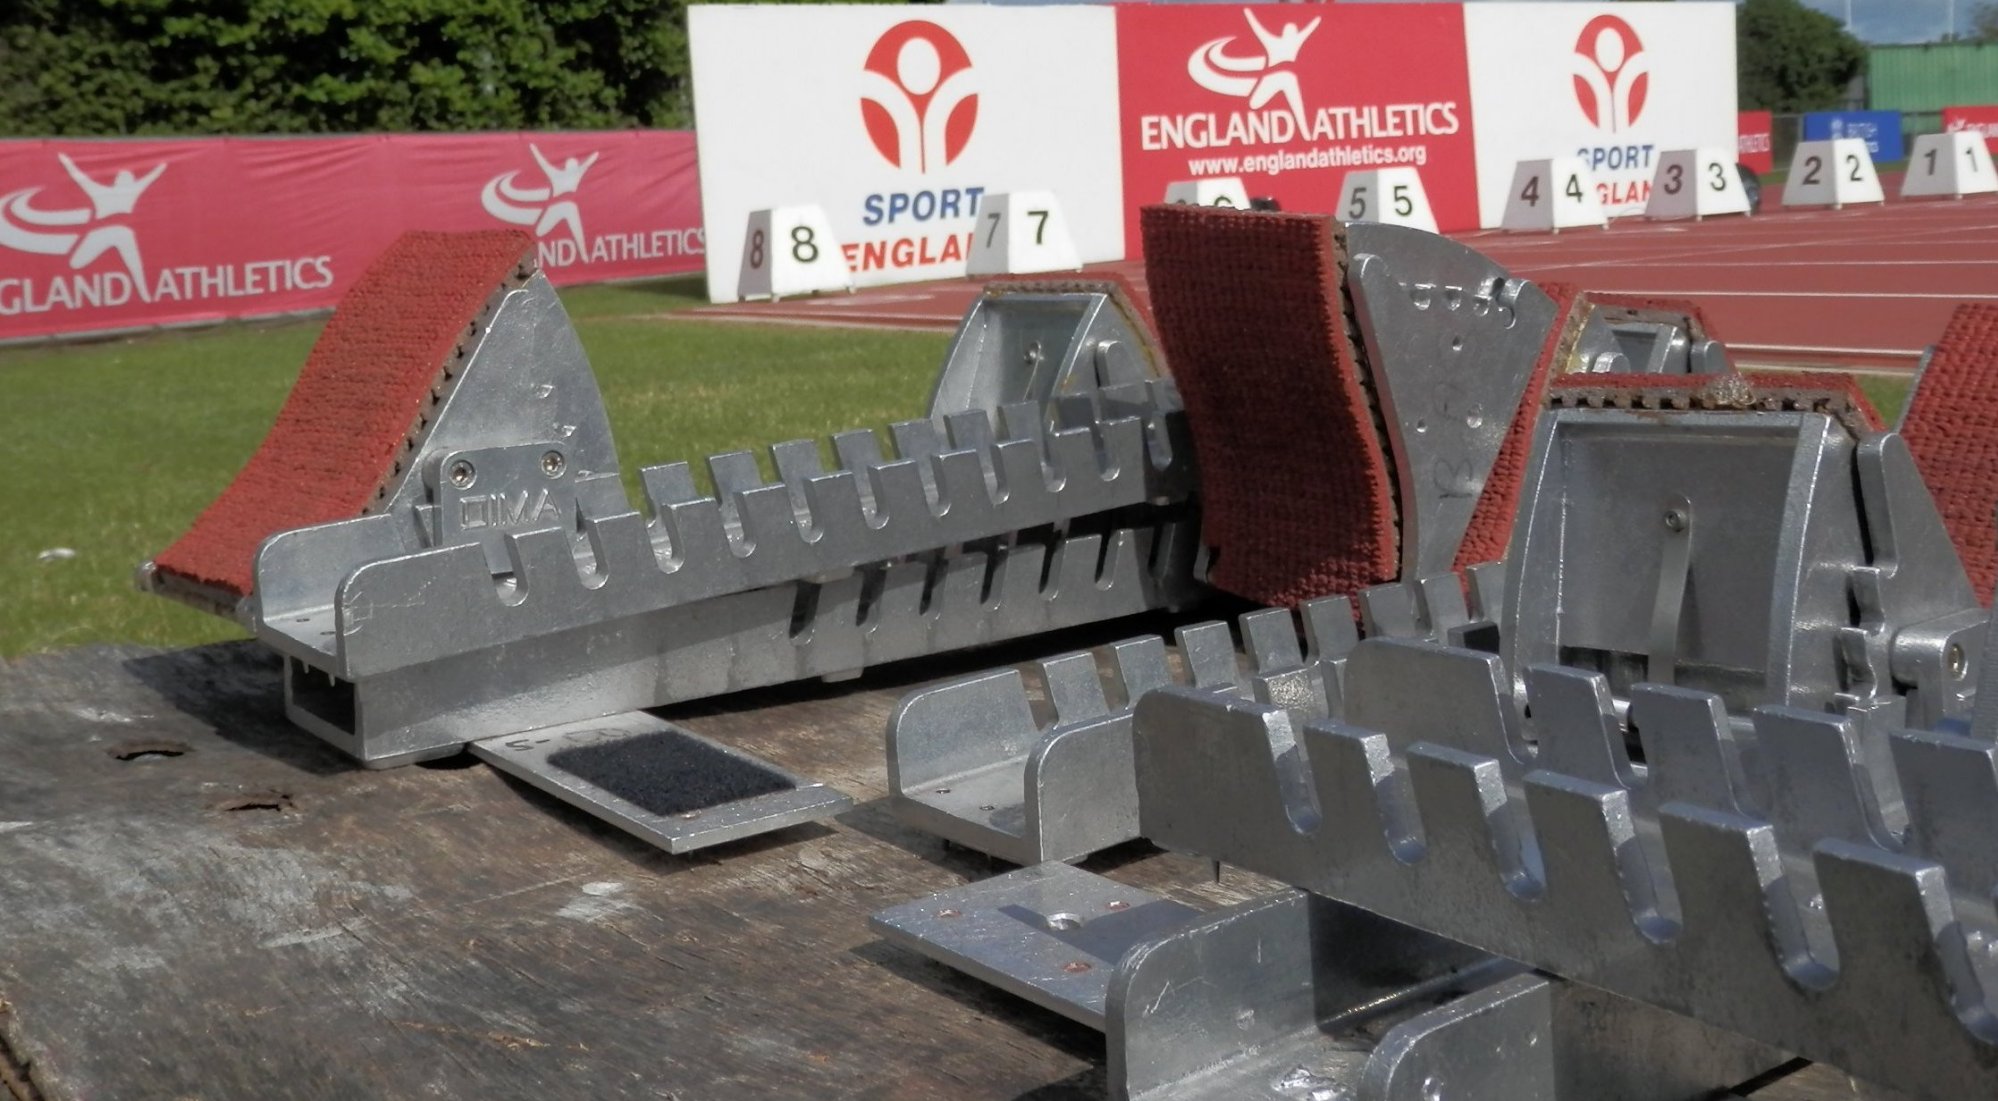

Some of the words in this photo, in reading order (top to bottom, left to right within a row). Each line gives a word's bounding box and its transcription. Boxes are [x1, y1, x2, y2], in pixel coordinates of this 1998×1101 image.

[1141, 109, 1295, 151] ENGLAND
[1312, 101, 1459, 141] ATHLETICS
[1188, 144, 1427, 176] www.englandathletics.org
[1802, 156, 1822, 185] 2
[1846, 154, 1864, 182] 2
[1924, 148, 1938, 176] 1
[1966, 147, 1979, 173] 1
[1521, 175, 1540, 207] 4
[1566, 173, 1583, 203] 4
[1664, 164, 1684, 195] 3
[1709, 162, 1727, 192] 3
[863, 186, 985, 226] SPORT
[1348, 187, 1369, 220] 5
[1393, 185, 1413, 216] 5
[791, 225, 820, 263] 8
[986, 212, 1001, 249] 7
[1026, 210, 1050, 246] 7
[749, 229, 765, 270] 8
[841, 232, 973, 273] ENGLA
[152, 254, 334, 303] ATHLETICS
